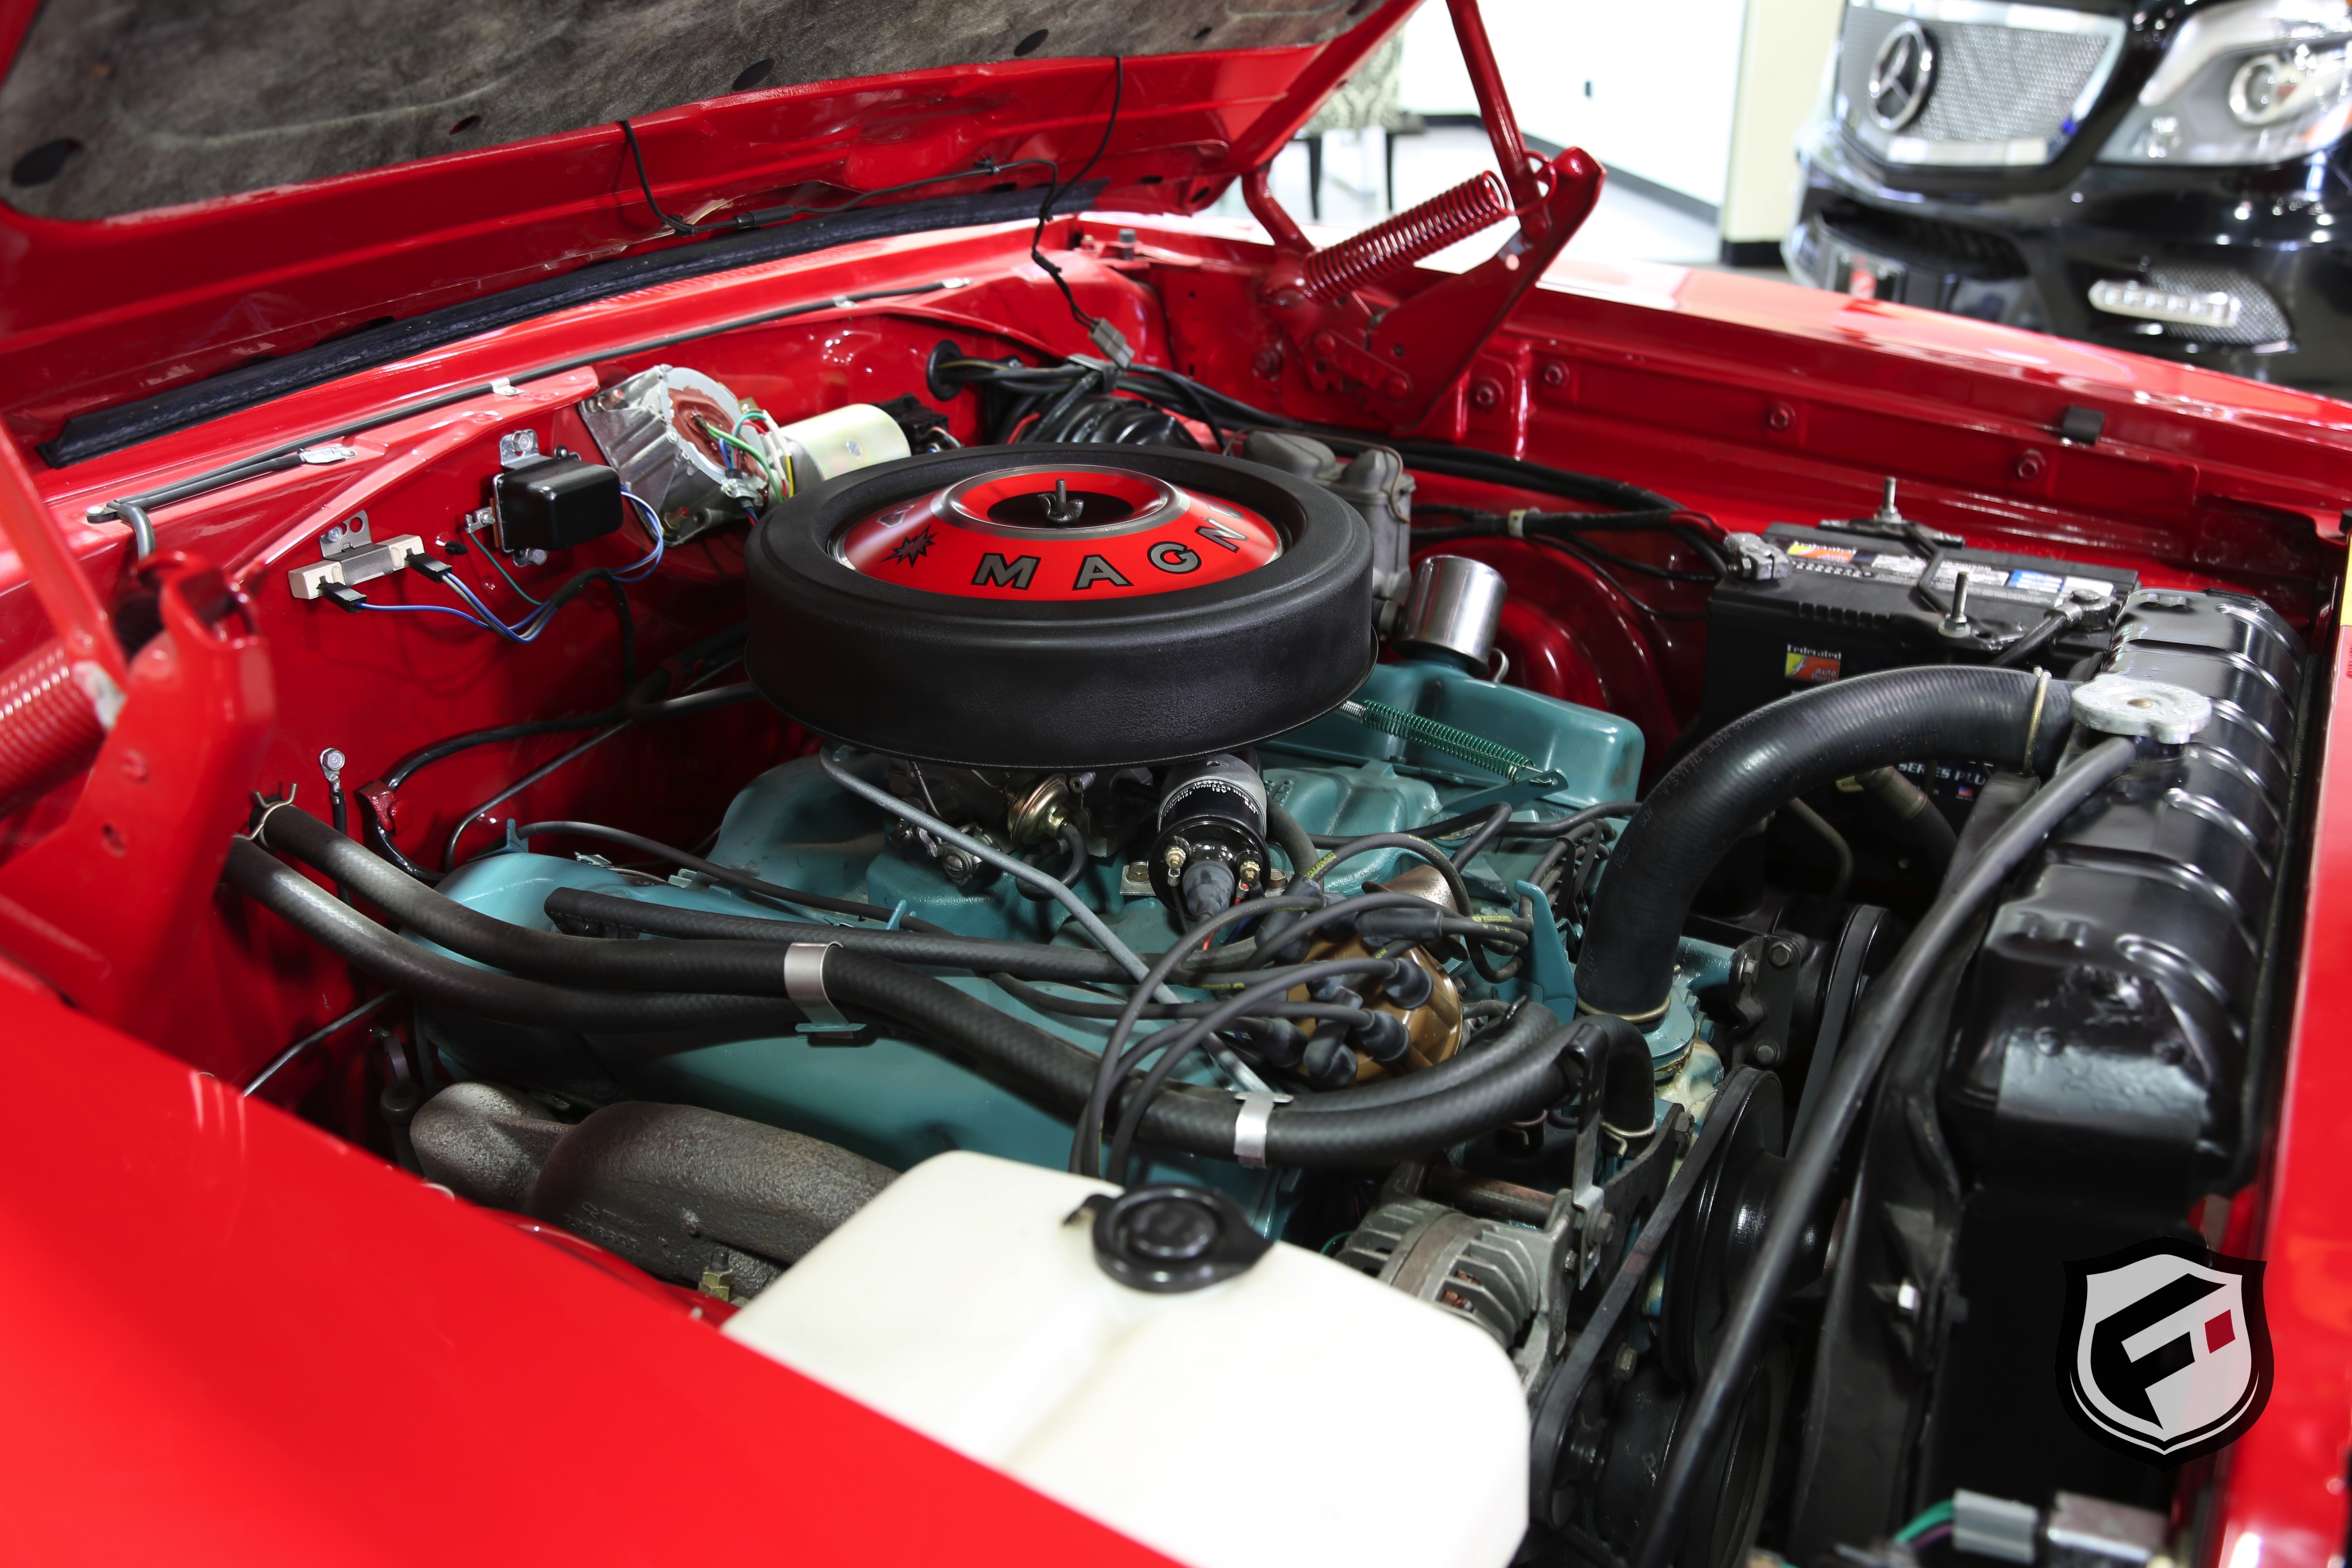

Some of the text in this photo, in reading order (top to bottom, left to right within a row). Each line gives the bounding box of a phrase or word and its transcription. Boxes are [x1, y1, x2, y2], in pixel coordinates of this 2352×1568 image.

[971, 495, 1250, 591] MAGNU
[1787, 644, 1842, 660] Federated
[1815, 667, 1837, 676] Auto
[1898, 761, 1987, 786] SERES PLU
[1233, 789, 1250, 802] WITH
